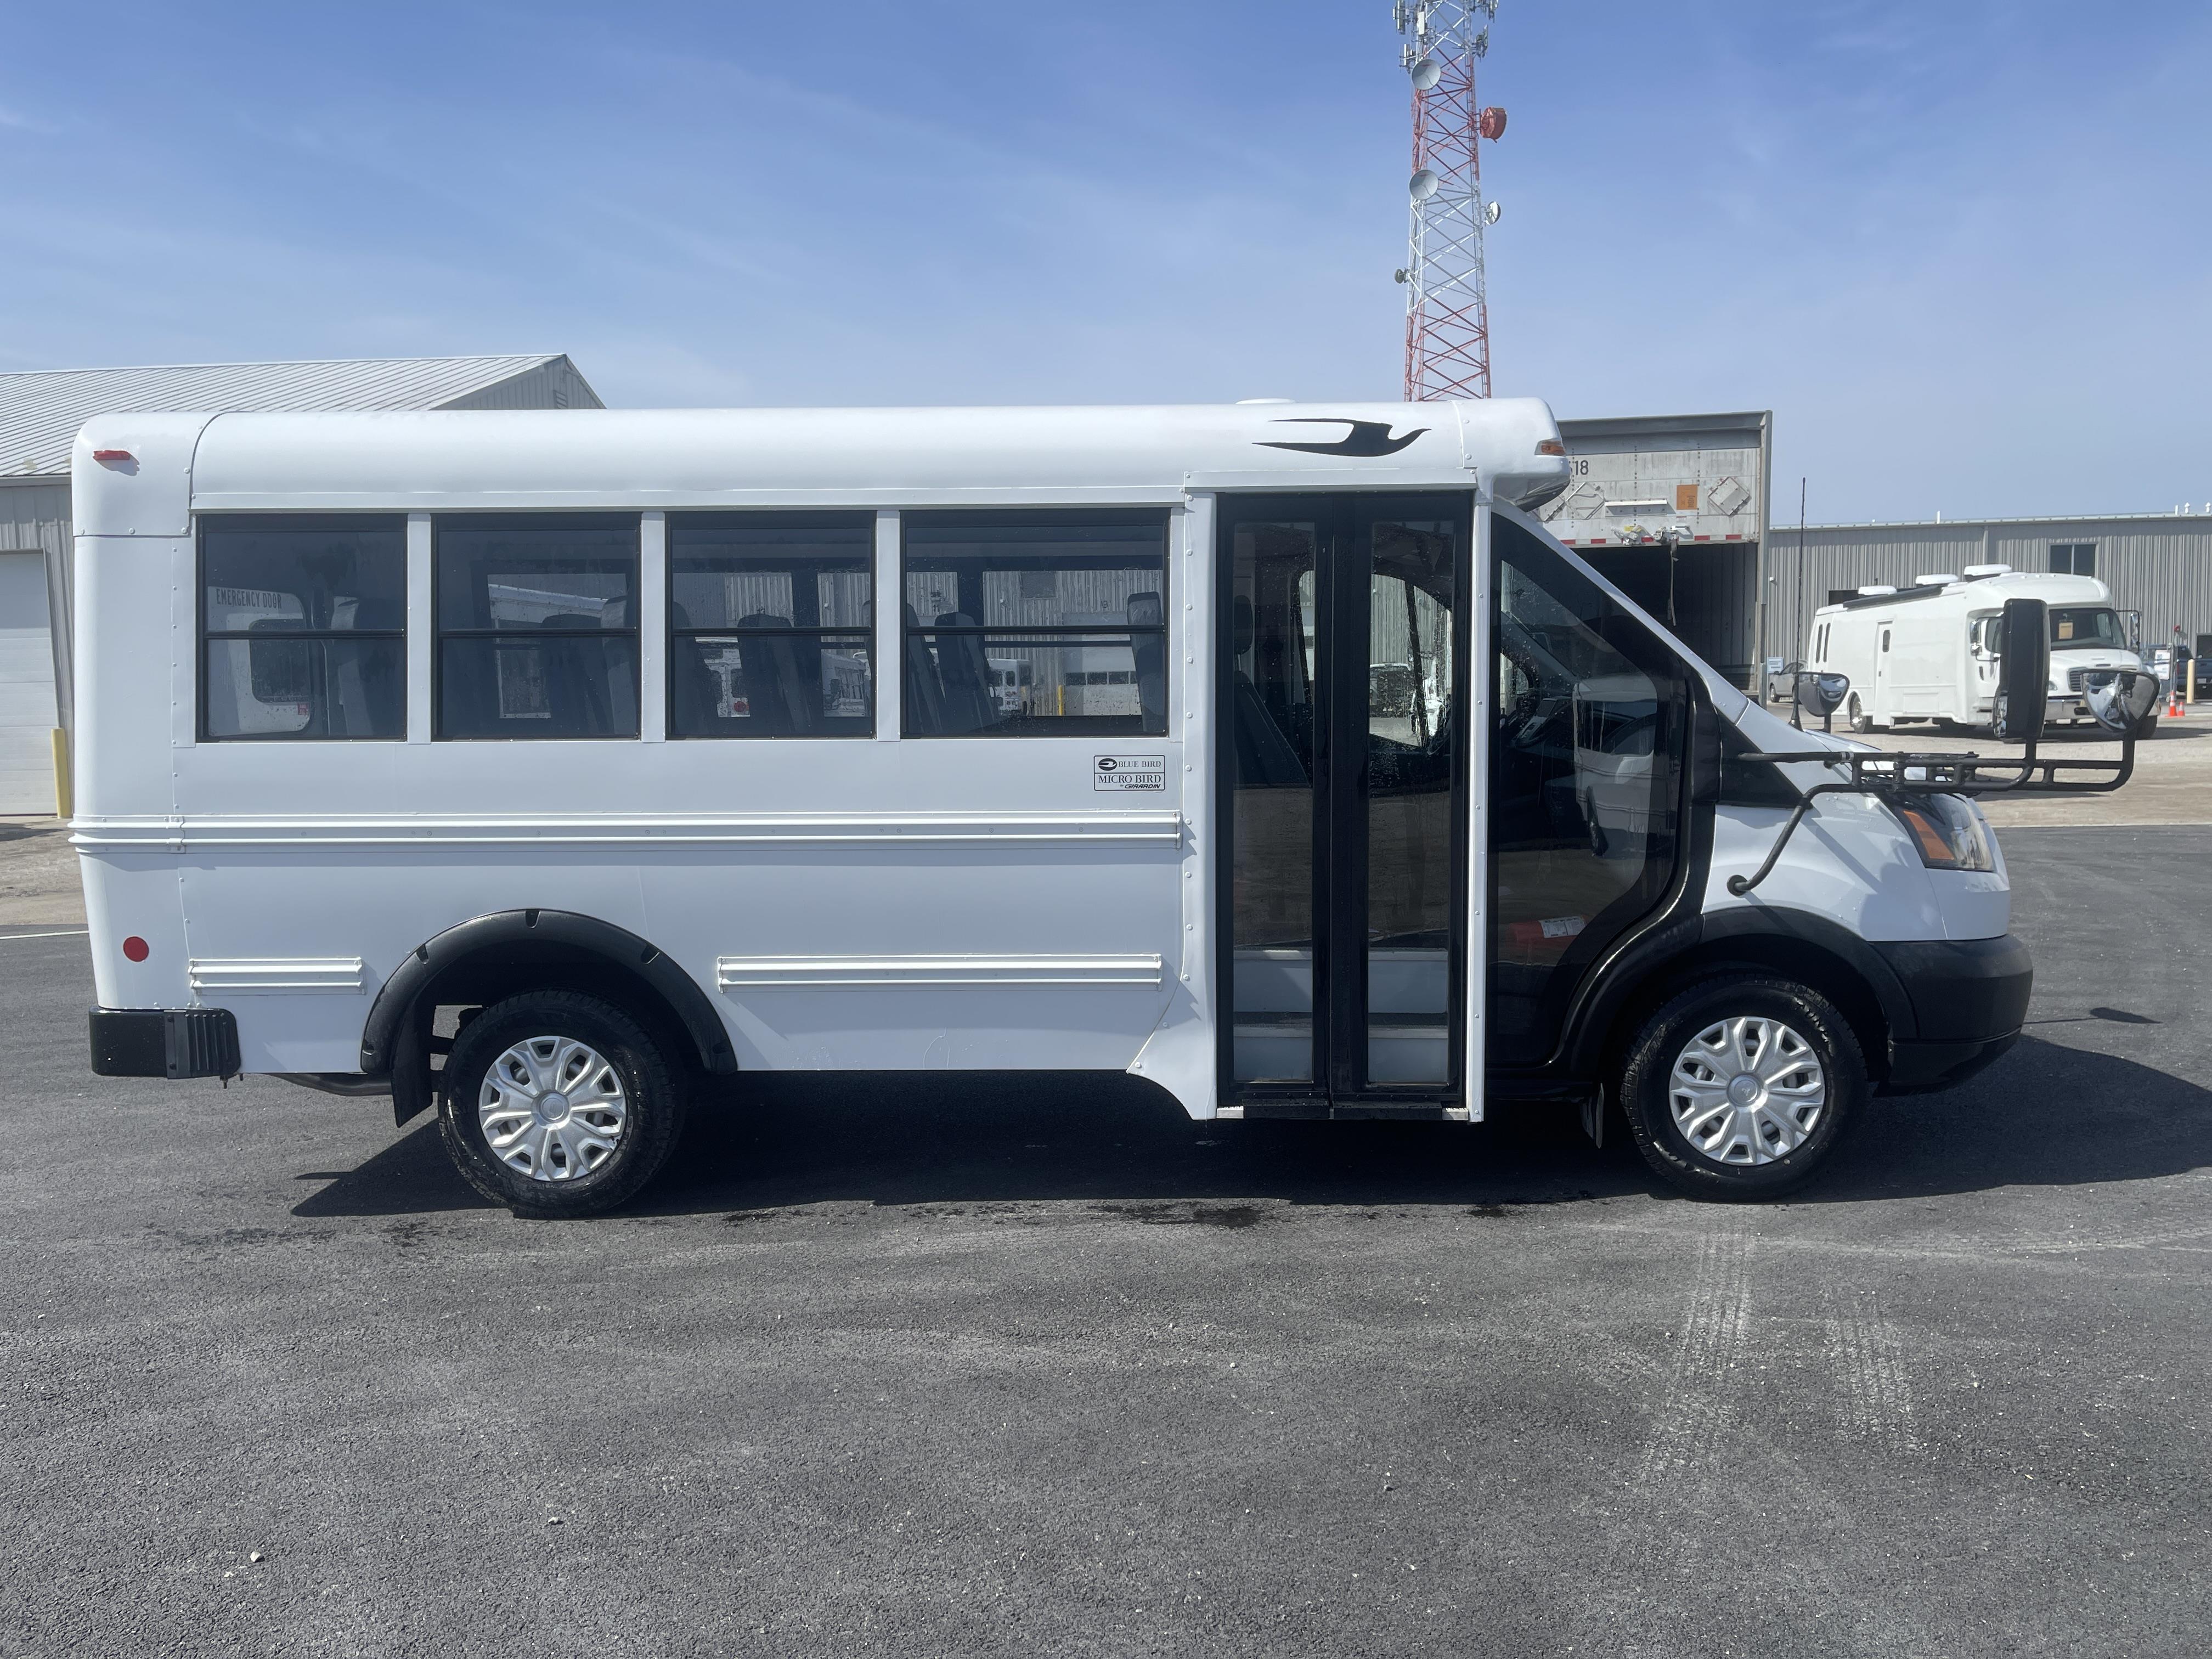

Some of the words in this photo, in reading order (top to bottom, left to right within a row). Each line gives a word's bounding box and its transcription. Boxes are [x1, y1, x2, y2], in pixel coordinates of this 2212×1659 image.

[216, 588, 261, 607] EMERGENCY
[262, 592, 282, 610] DOOR
[1098, 775, 1132, 783] MICRO
[1136, 775, 1161, 783] BIRD
